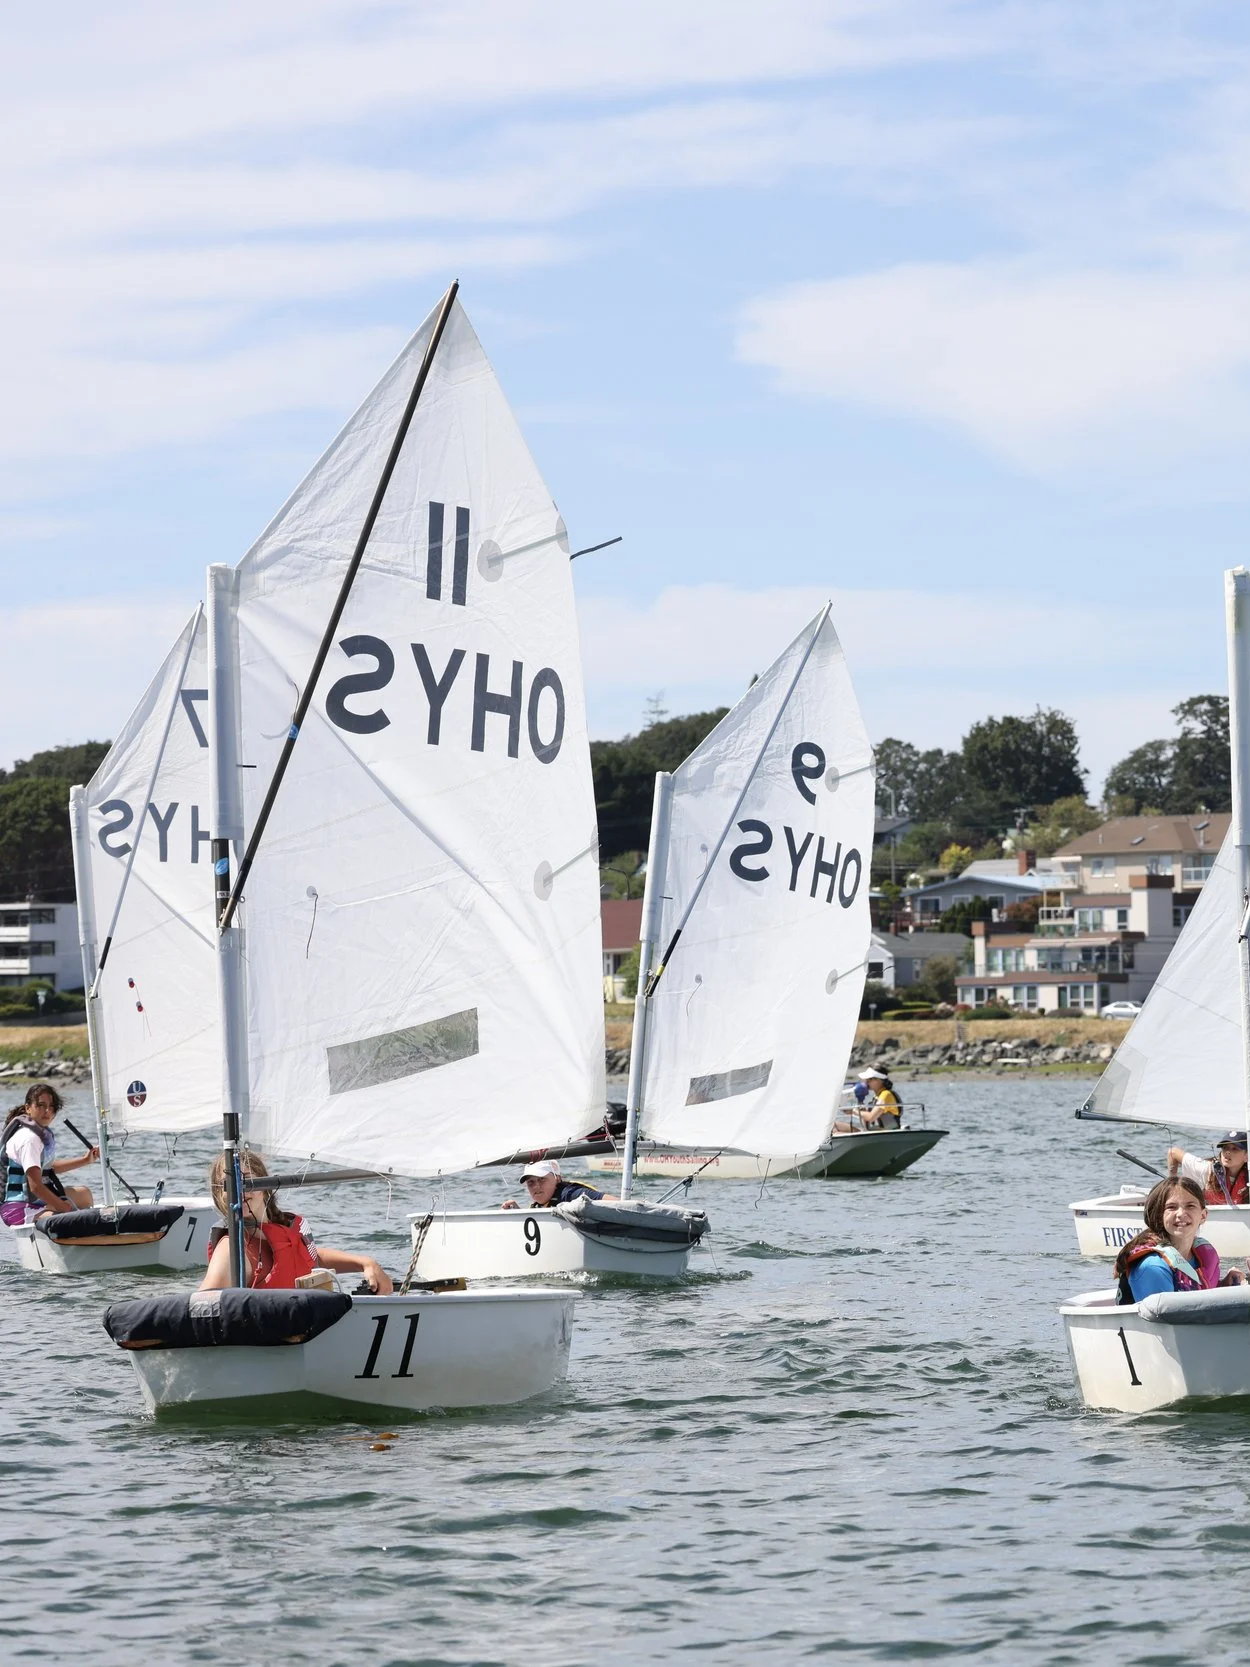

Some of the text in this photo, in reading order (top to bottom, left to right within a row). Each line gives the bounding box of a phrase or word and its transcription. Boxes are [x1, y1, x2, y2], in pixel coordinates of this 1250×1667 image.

[184, 1216, 198, 1252] 7
[523, 1216, 541, 1256] 9
[354, 1313, 420, 1379] 11
[1117, 1326, 1142, 1386] 1
